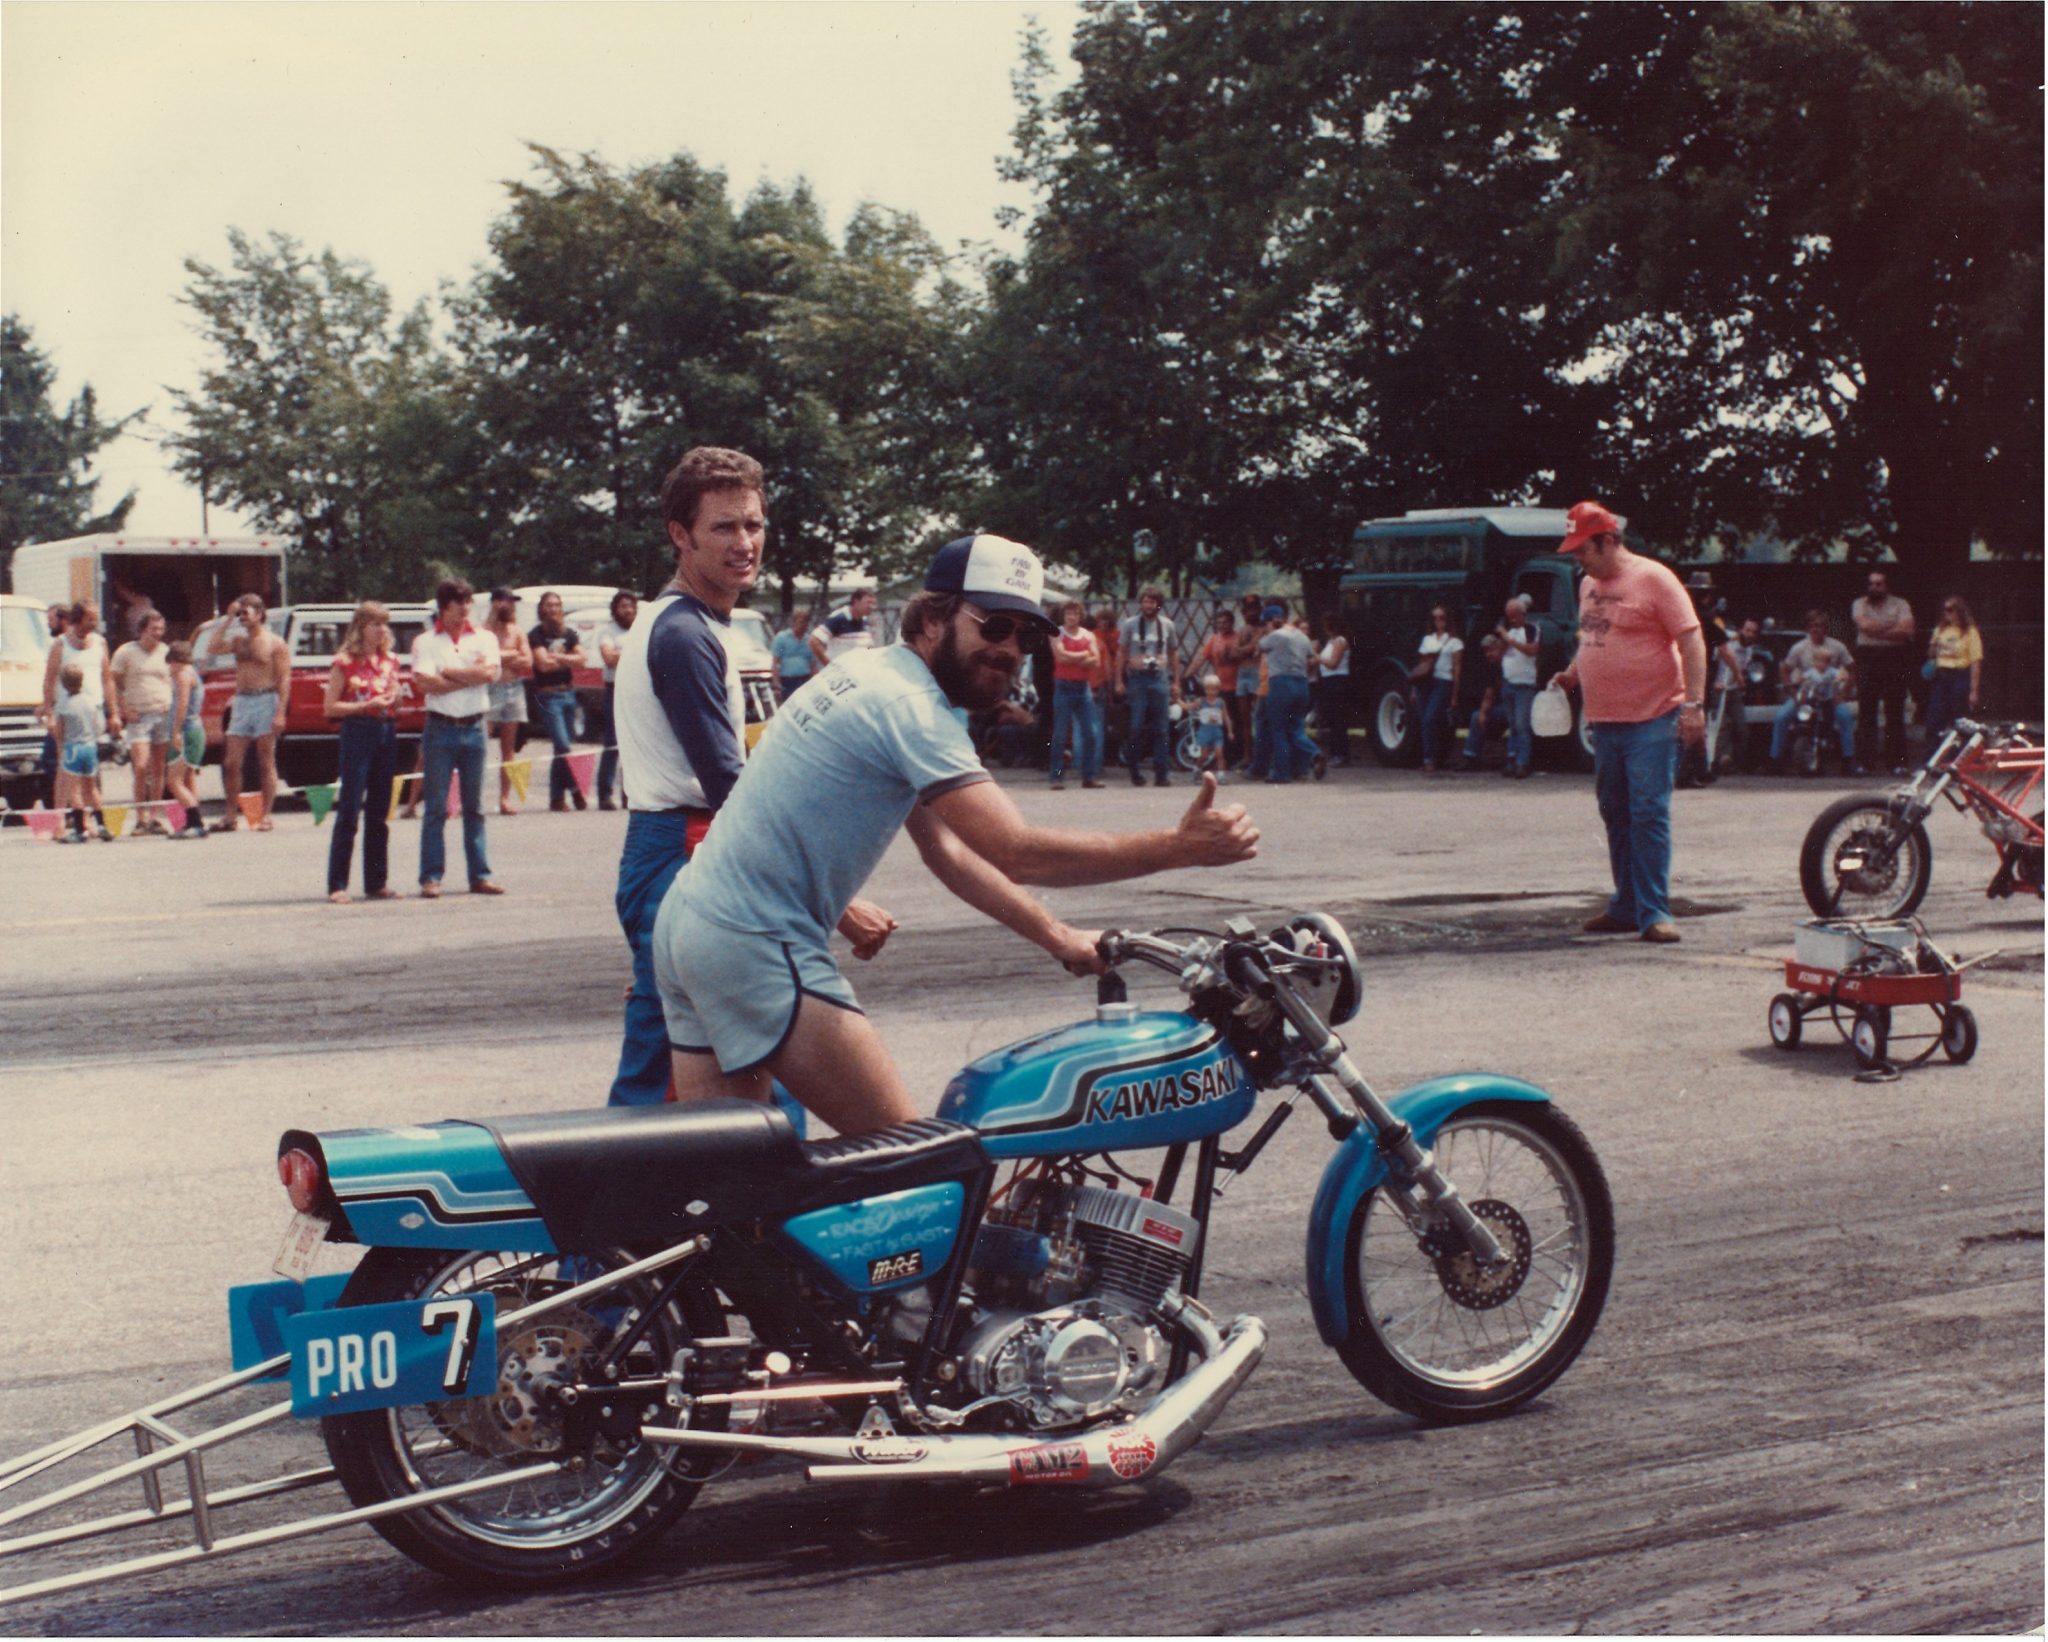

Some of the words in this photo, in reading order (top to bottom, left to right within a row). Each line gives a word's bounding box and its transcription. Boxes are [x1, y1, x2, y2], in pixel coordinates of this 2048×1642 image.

[1085, 1056, 1238, 1126] KAWASAKI
[307, 1331, 398, 1397] PRO
[421, 1299, 481, 1394] 7
